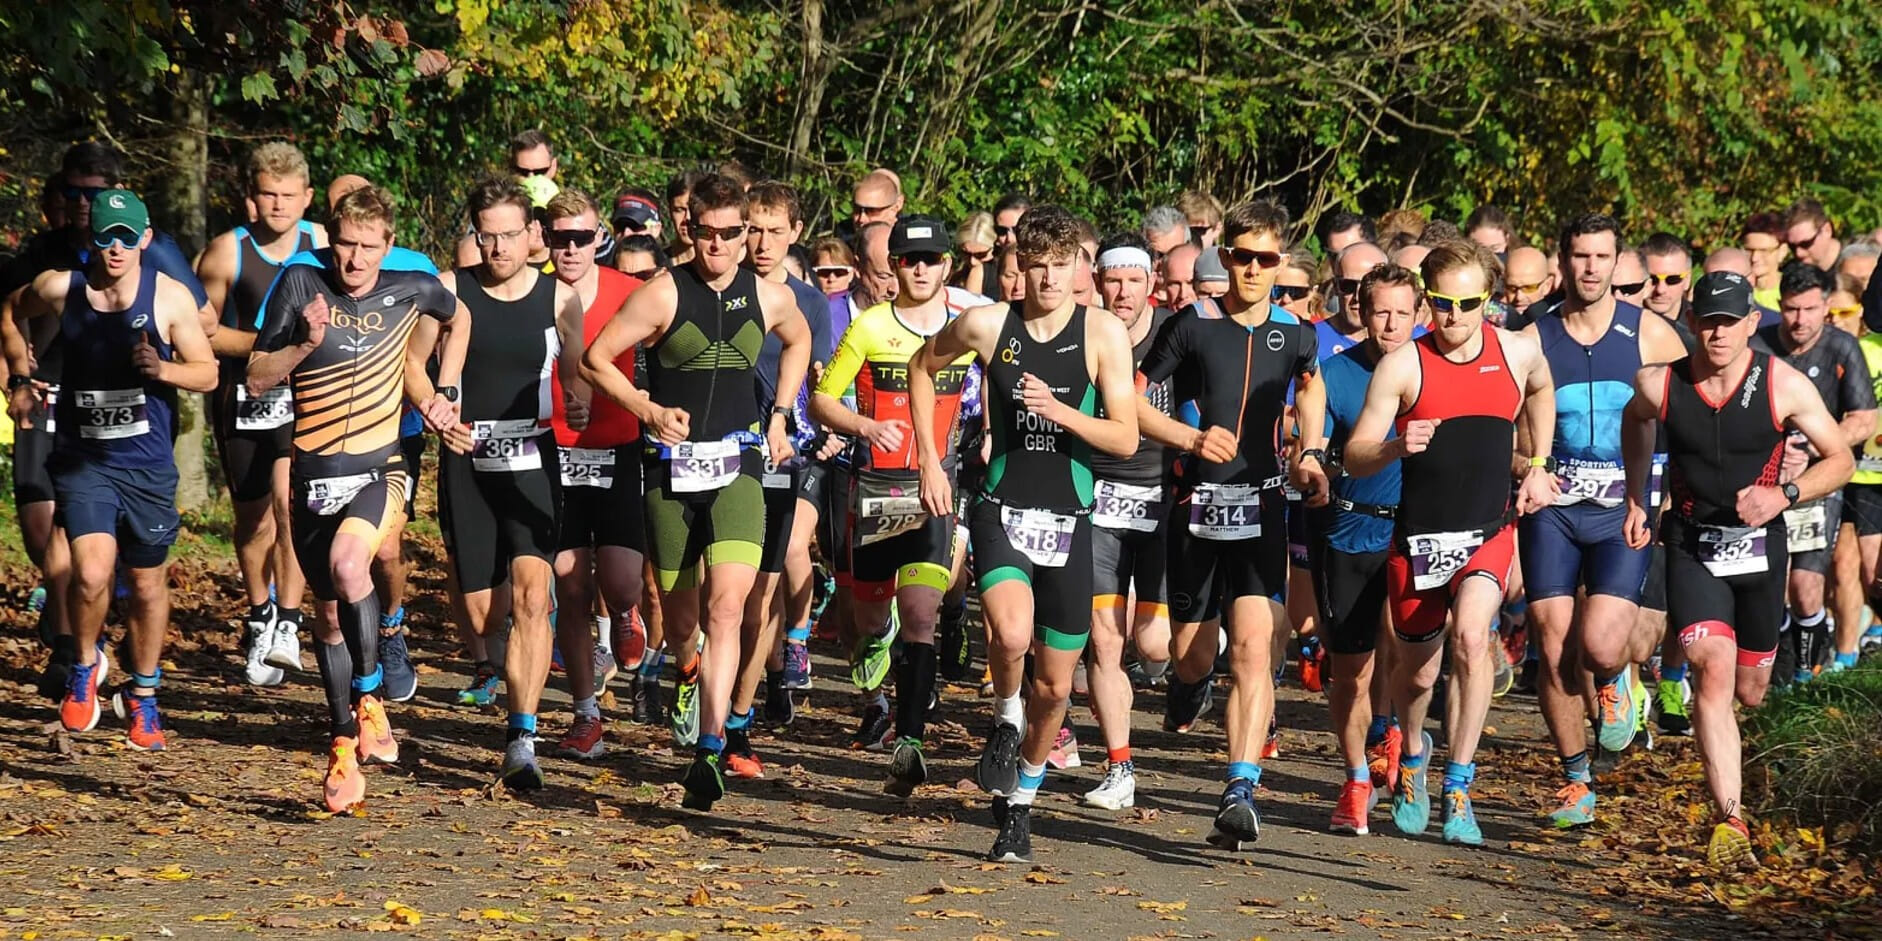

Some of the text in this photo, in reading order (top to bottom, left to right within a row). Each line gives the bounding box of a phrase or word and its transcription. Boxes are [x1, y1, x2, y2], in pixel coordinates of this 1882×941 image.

[877, 367, 967, 383] TR FIT
[91, 407, 134, 426] 373
[250, 401, 288, 419] 236
[485, 438, 524, 458] 361
[1024, 433, 1056, 454] GBR
[561, 463, 601, 481] 225
[686, 457, 725, 479] 331
[1262, 476, 1284, 490] ZO
[1568, 478, 1613, 498] 297
[1106, 498, 1147, 518] 326
[1204, 505, 1246, 526] 314
[876, 514, 917, 534] 278
[1014, 527, 1058, 551] 318
[1713, 540, 1753, 562] 352
[1428, 548, 1469, 575] 253
